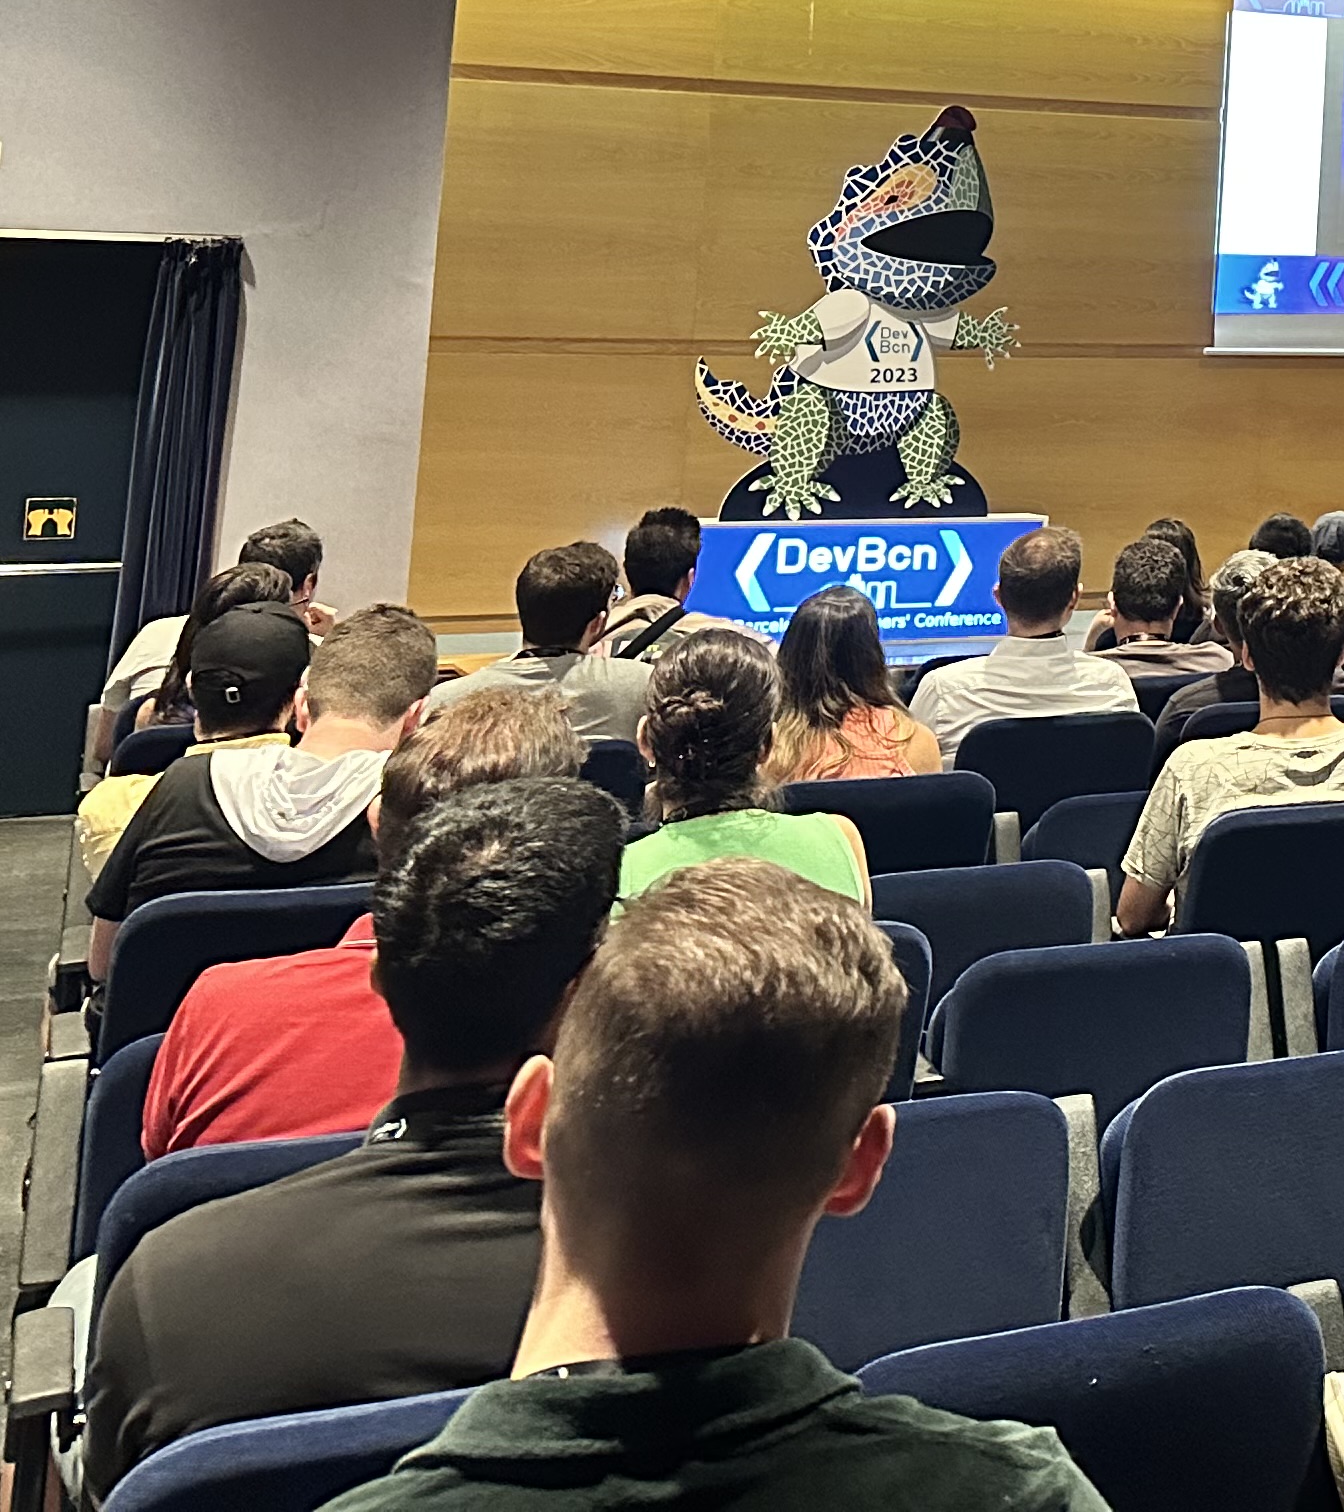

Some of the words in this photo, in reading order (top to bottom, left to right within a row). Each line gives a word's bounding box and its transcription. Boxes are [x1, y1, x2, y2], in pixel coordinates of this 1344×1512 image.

[879, 326, 910, 342] Dev
[879, 340, 911, 356] Bcn
[869, 367, 919, 384] 2023
[776, 537, 938, 575] DevBcn
[915, 611, 1002, 628] Conference
